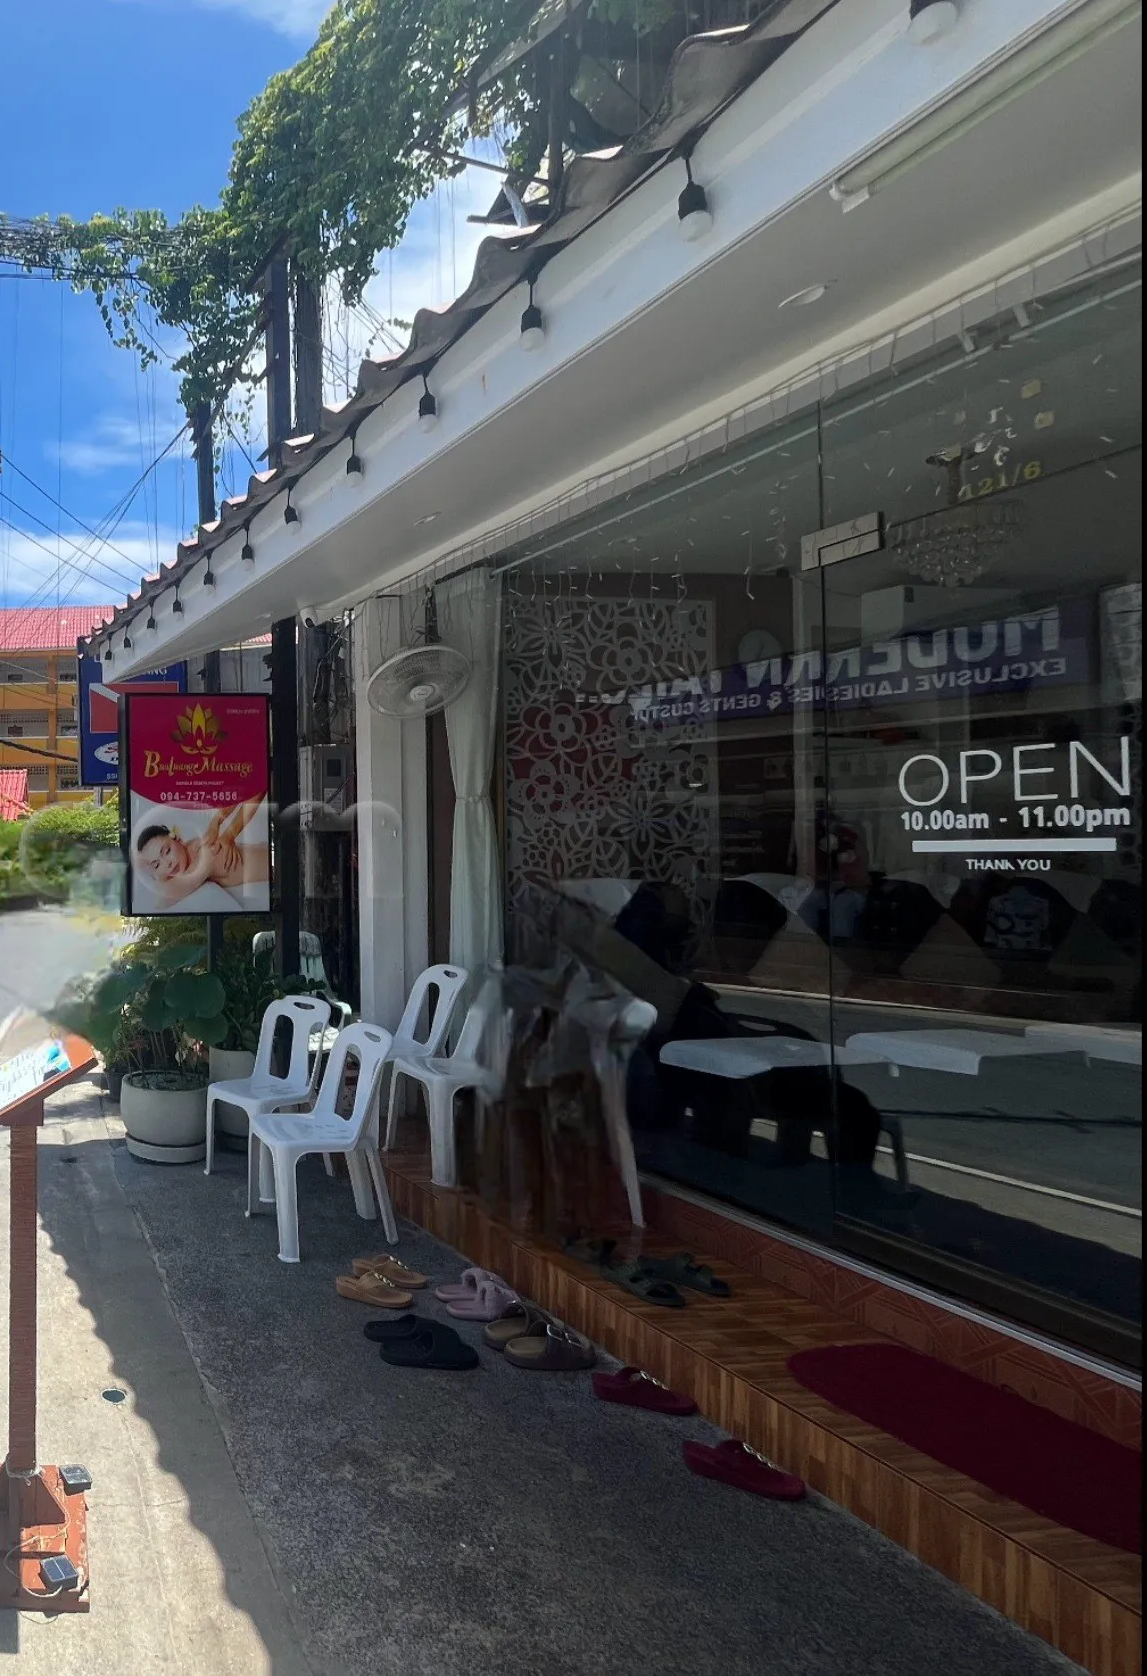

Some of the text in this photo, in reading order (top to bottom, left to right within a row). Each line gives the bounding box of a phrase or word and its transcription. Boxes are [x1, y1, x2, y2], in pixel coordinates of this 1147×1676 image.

[195, 757, 254, 779] Massage
[898, 736, 1130, 807] OPEN
[901, 809, 989, 831] 10.00am
[1018, 804, 1130, 832] 11.00pm
[965, 858, 1051, 871] THANK YOU
